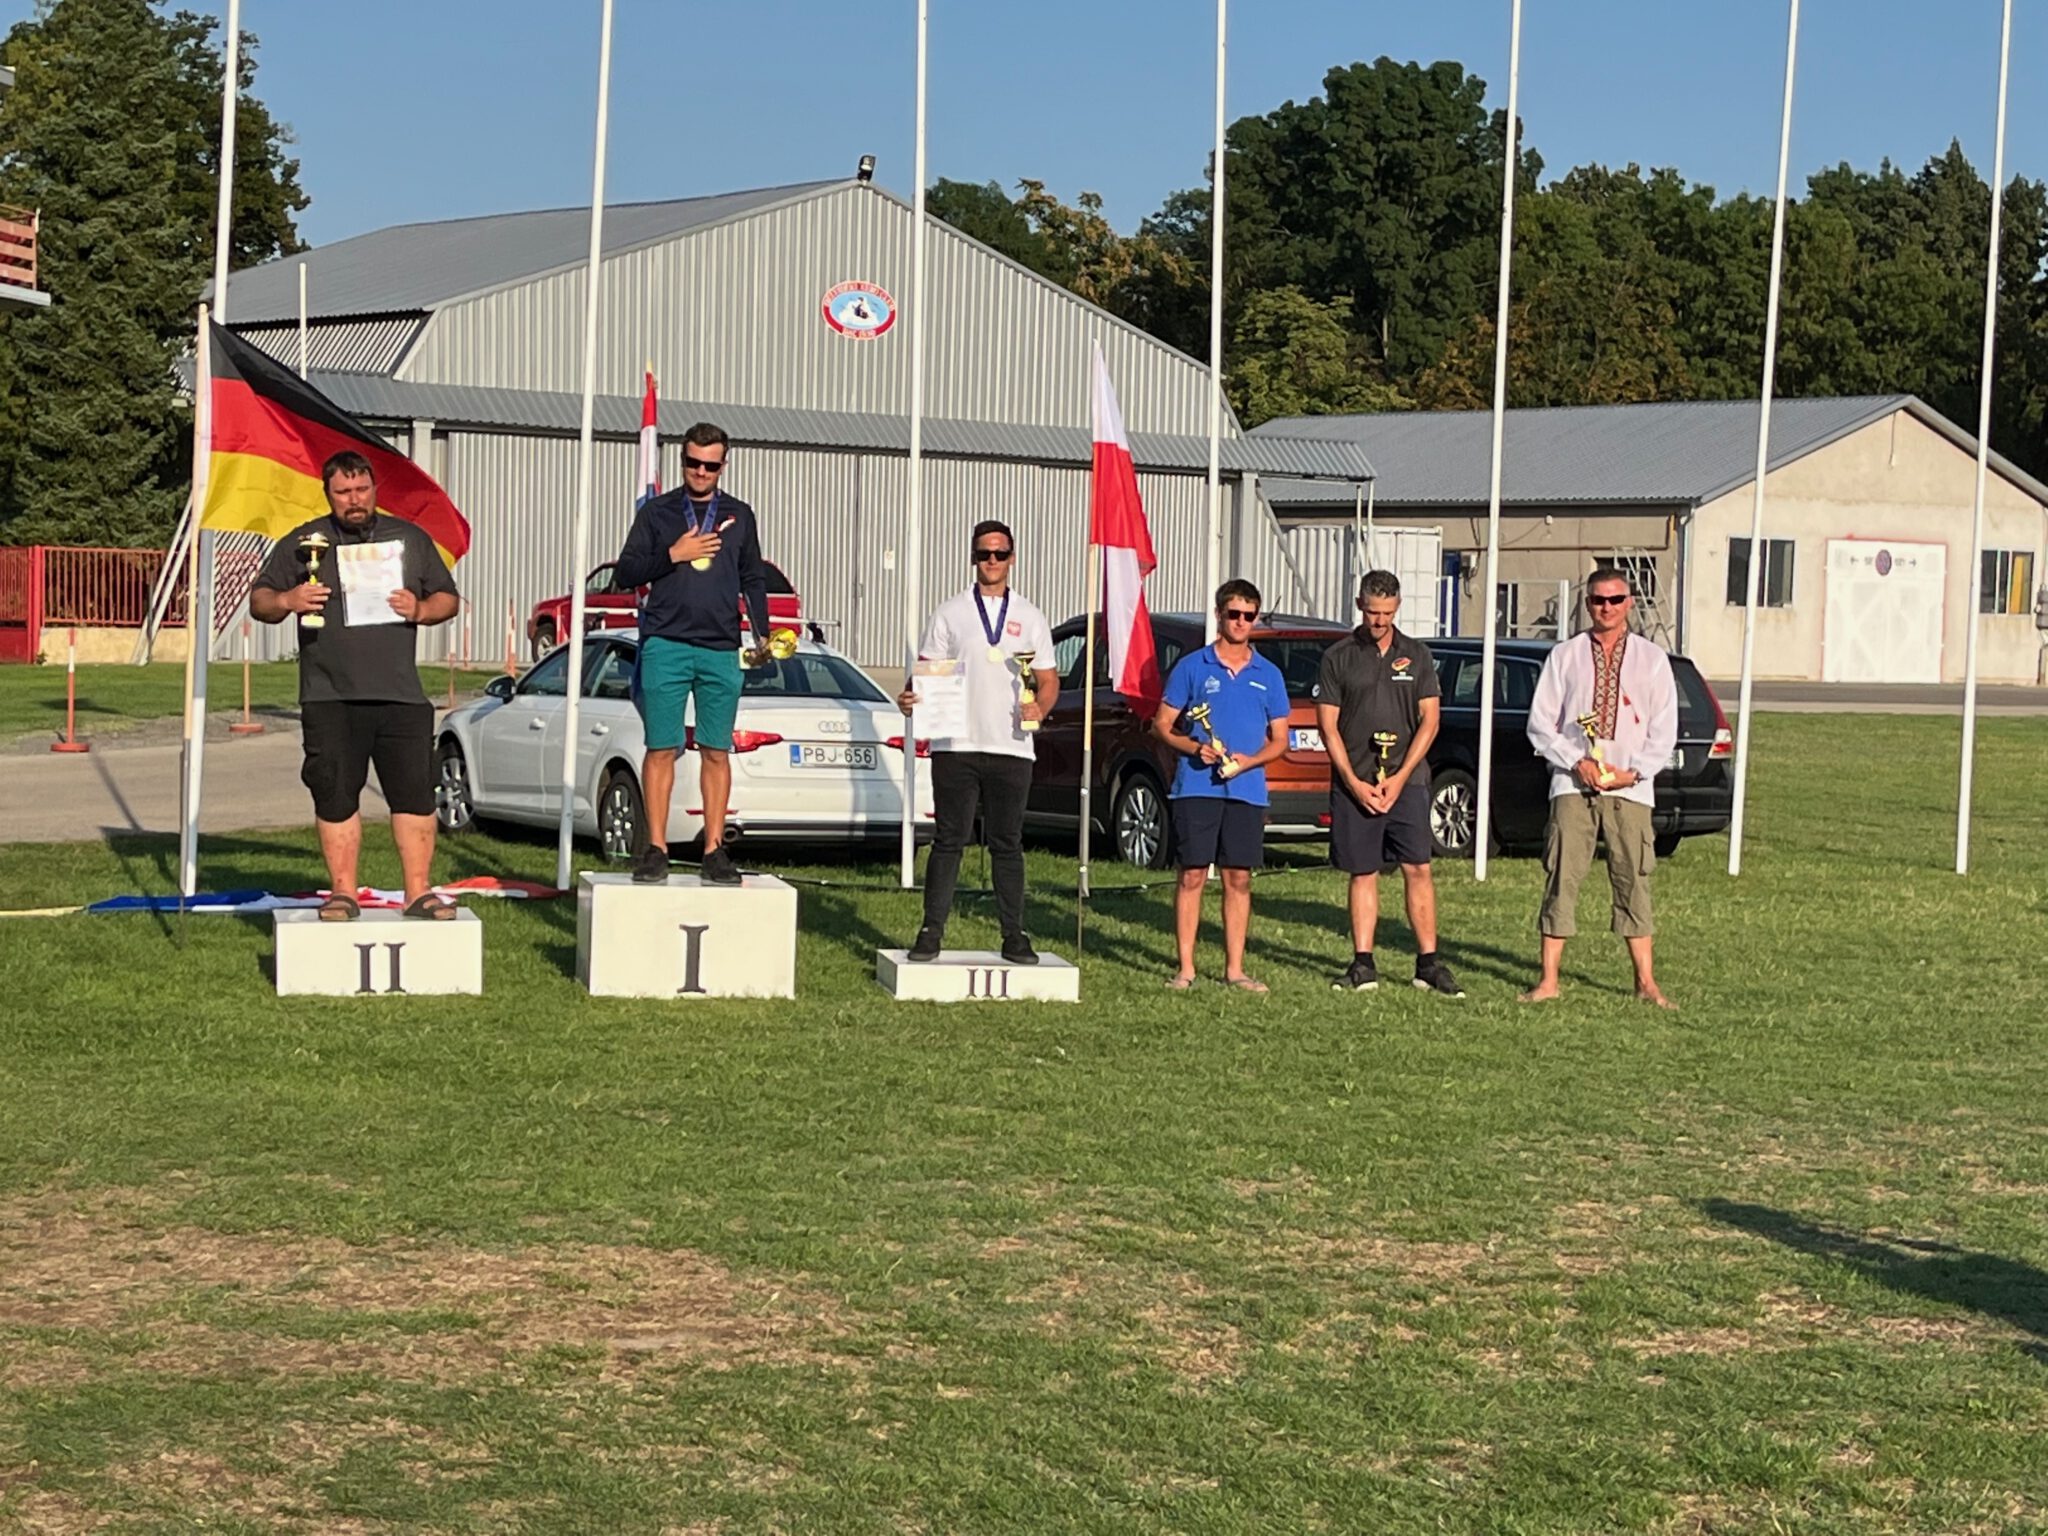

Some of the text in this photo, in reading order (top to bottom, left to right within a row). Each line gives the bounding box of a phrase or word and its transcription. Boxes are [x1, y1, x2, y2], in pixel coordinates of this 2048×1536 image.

[804, 747, 872, 764] PBJ-656
[354, 942, 406, 994] II
[677, 924, 709, 994] I
[967, 968, 1011, 998] III
